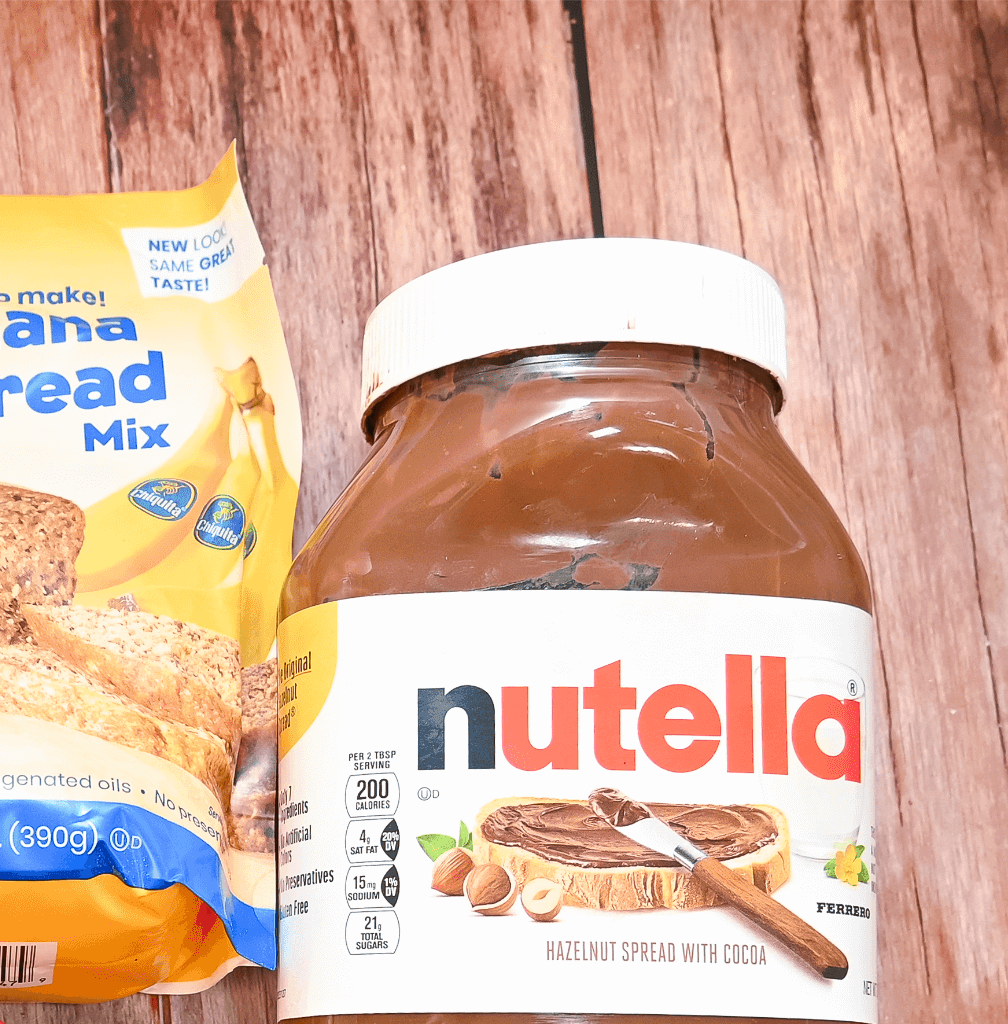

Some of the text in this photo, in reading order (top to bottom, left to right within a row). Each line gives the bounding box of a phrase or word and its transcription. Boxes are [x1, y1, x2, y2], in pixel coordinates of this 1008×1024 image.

[149, 239, 188, 252] NEW
[150, 238, 235, 272] SAME GREAT
[150, 276, 209, 292] TASTE!
[18, 286, 106, 307] make!
[83, 420, 171, 452] Mix
[130, 489, 183, 517] Chiquita
[196, 519, 239, 545] Chiquita
[417, 653, 862, 784] nutella
[348, 750, 396, 761] PER 2 TBSP
[354, 760, 390, 771] SERVING
[98, 777, 131, 794] oils
[155, 789, 176, 811] No
[357, 778, 389, 800] 200
[355, 800, 390, 811] CALORIES
[9, 820, 98, 855] (390g)
[382, 832, 400, 842] 20%
[350, 845, 378, 855] SAT FAT
[385, 842, 397, 851] DV
[384, 877, 398, 887] 1%
[347, 891, 380, 901] SODIUM
[385, 887, 397, 897] DV
[294, 900, 309, 916] Free
[816, 902, 871, 919] FERRERO
[361, 932, 383, 941] TOTAL
[356, 940, 388, 950] SUGARS
[546, 940, 767, 965] HAZELNUT SPREAD WITH COCOA
